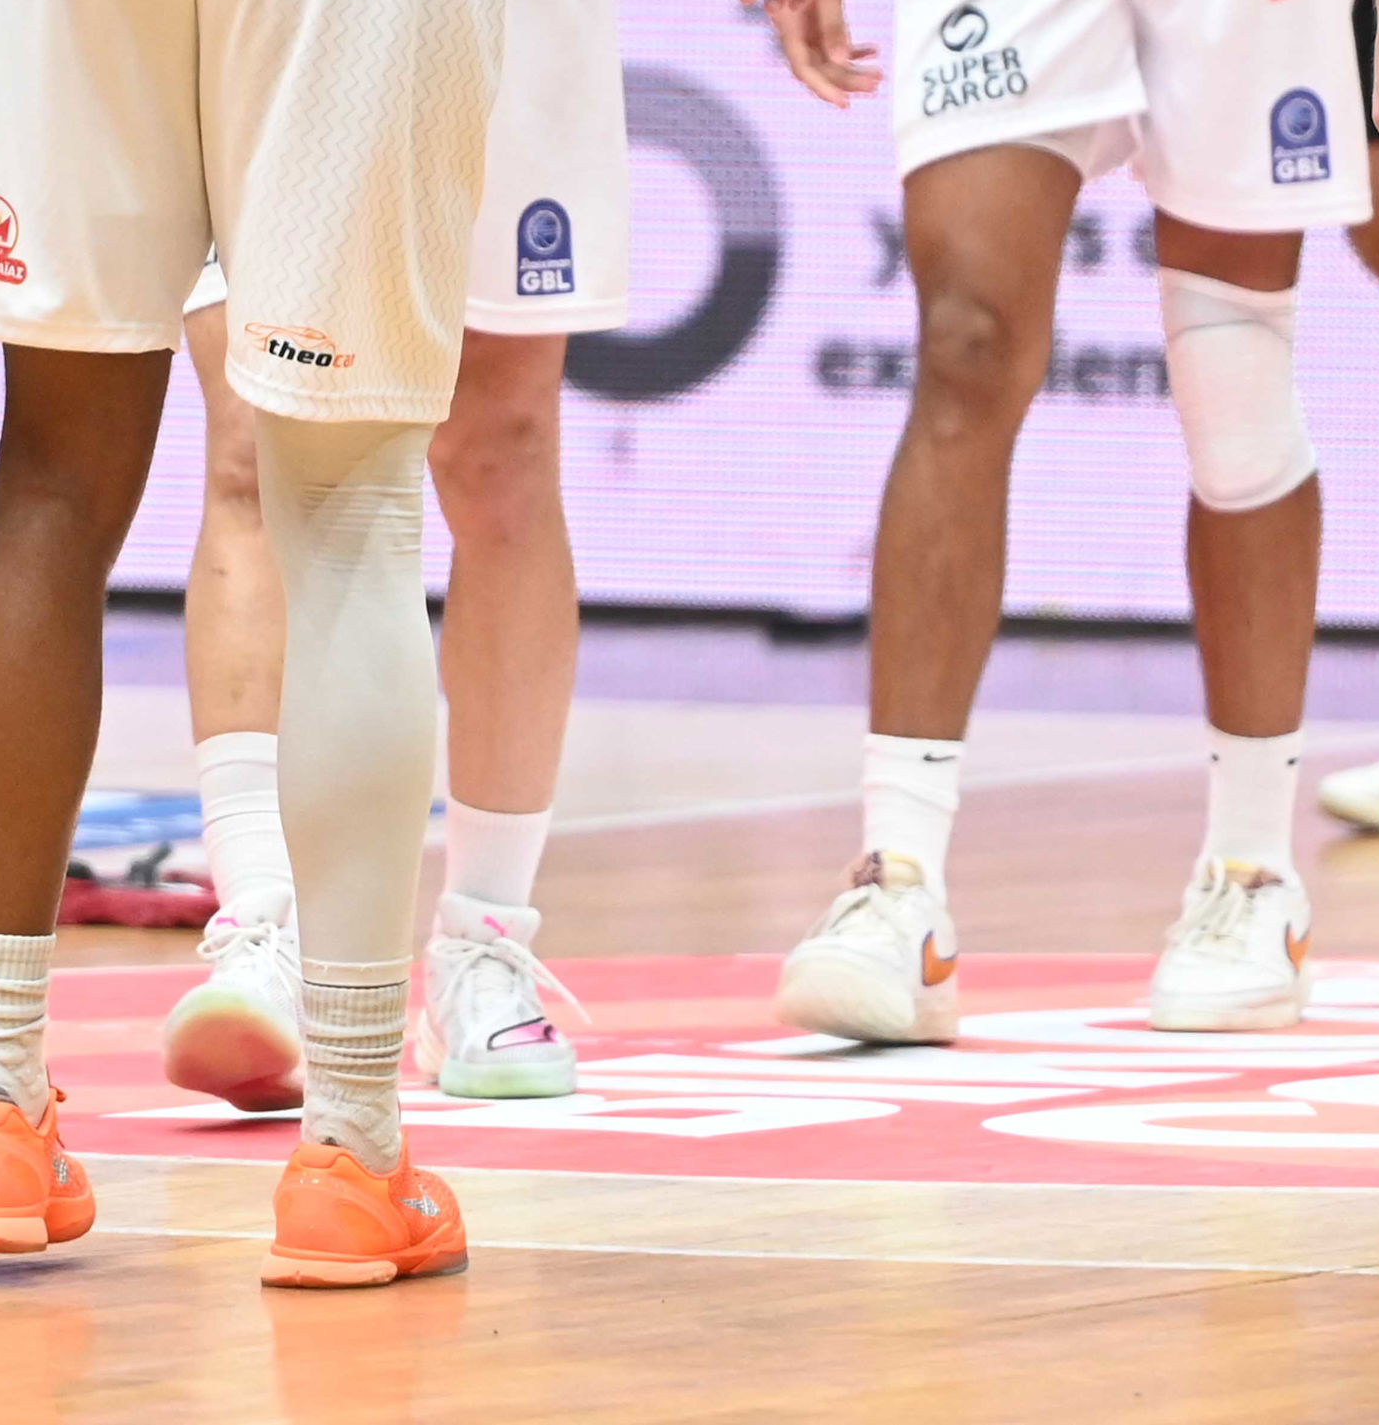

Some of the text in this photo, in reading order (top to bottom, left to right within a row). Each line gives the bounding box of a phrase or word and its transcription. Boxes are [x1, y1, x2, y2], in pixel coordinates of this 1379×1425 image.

[923, 47, 1021, 85] SUPER
[923, 71, 1028, 116] CARGO
[521, 269, 572, 292] GBL
